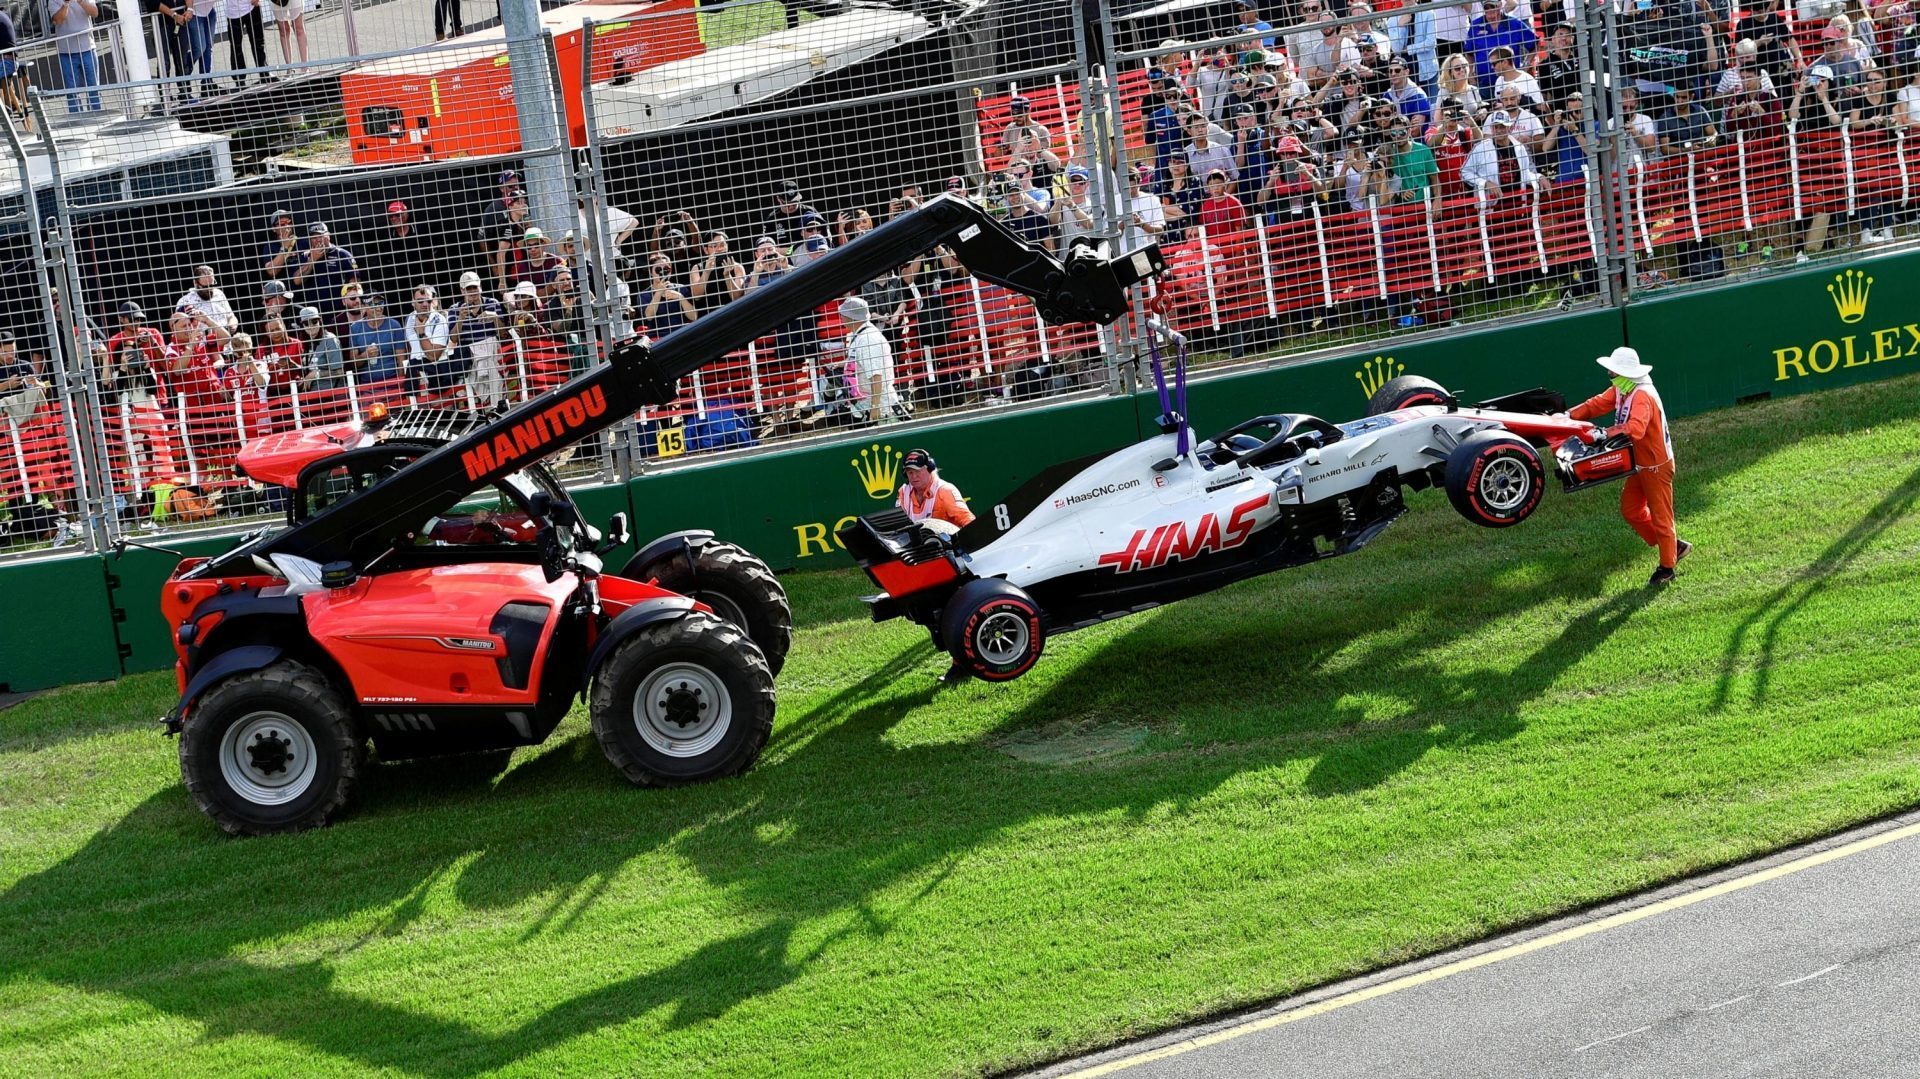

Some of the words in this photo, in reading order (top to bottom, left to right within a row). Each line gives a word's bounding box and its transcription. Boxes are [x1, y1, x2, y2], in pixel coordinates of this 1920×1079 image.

[461, 384, 607, 481] MANITOU
[660, 432, 682, 452] 15
[1308, 469, 1342, 484] RICHARD
[1343, 461, 1368, 473] MILLE
[1066, 477, 1141, 505] HaasCNC.com
[993, 503, 1011, 531] 8
[1098, 493, 1272, 575] HAAS
[462, 639, 492, 649] MANITOU
[963, 613, 978, 659] ZERO
